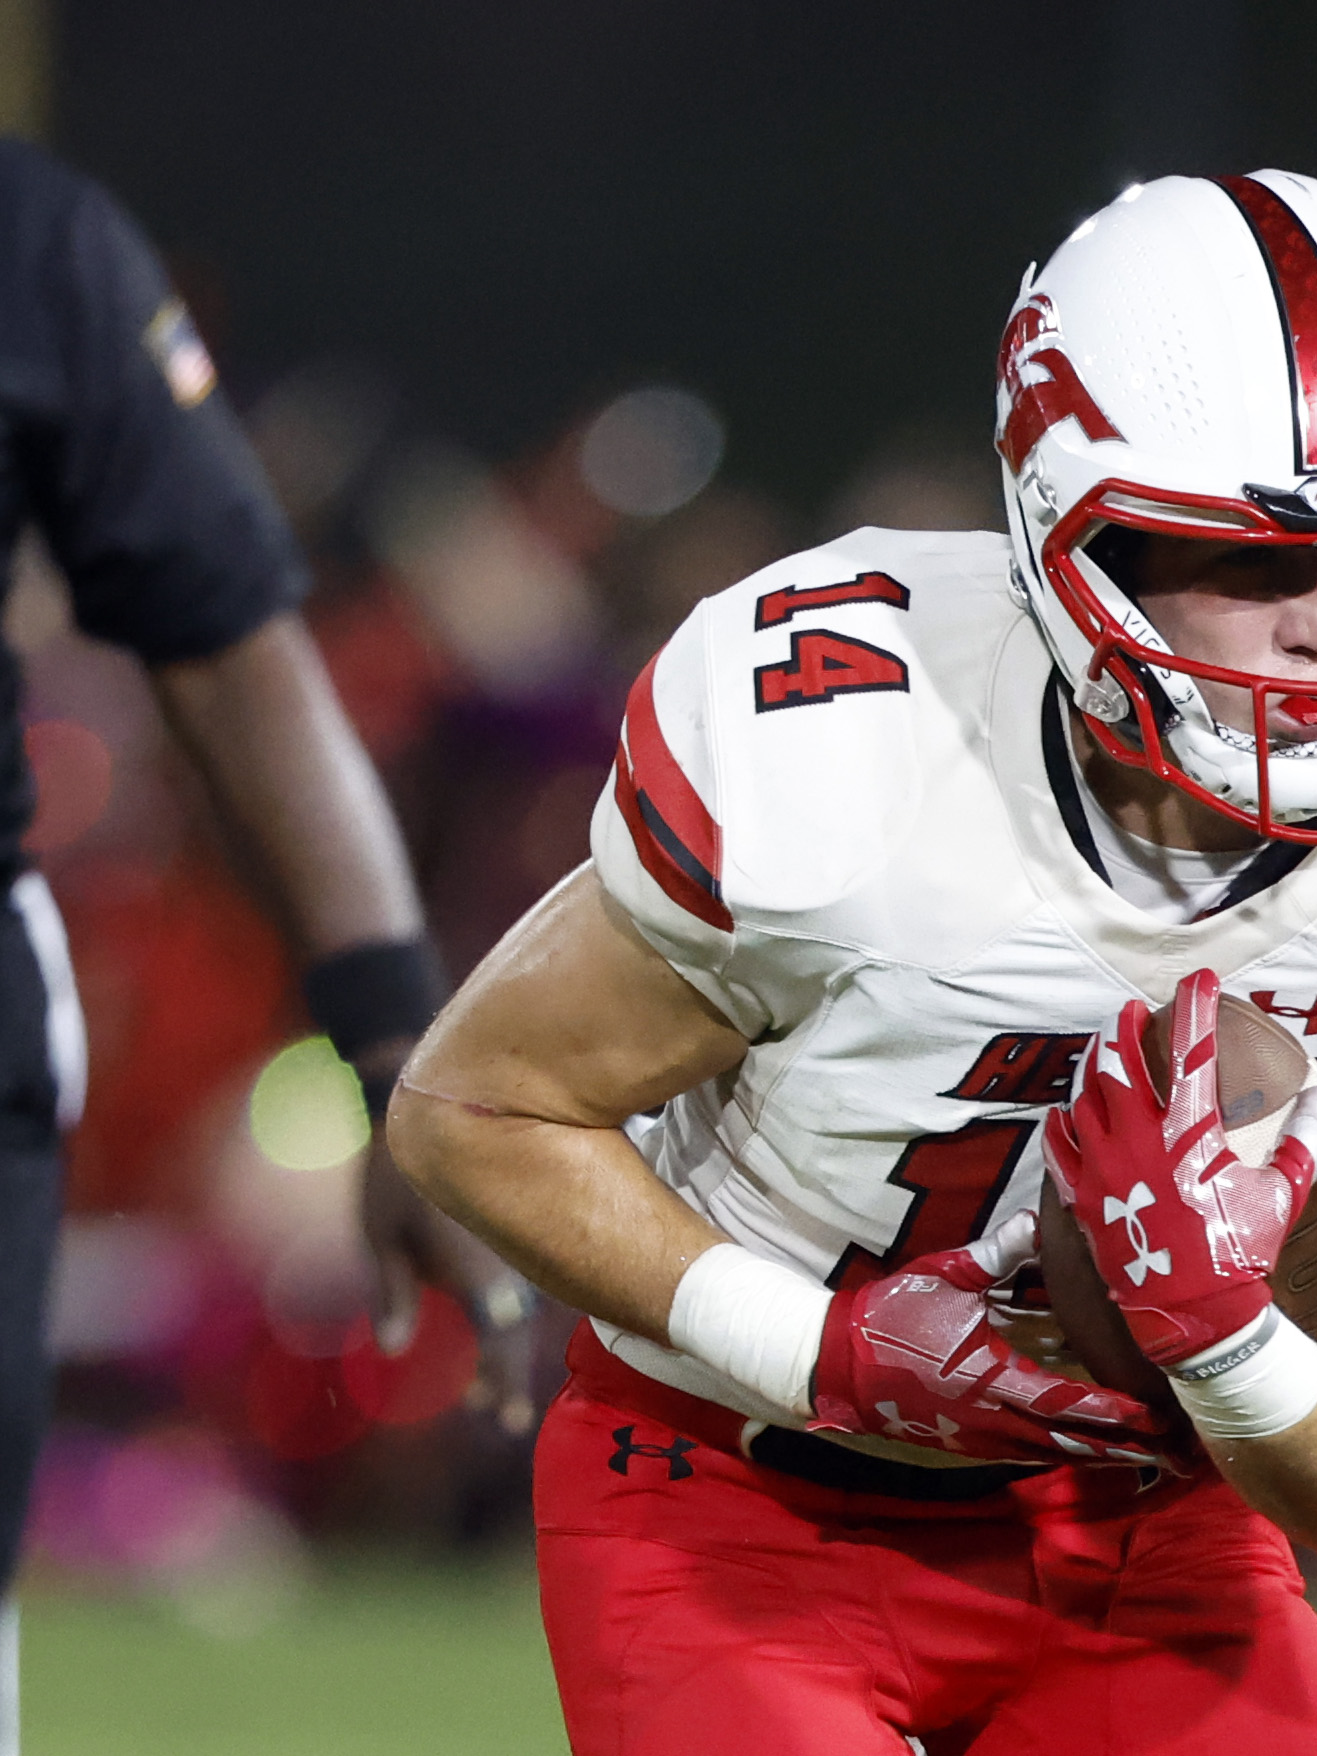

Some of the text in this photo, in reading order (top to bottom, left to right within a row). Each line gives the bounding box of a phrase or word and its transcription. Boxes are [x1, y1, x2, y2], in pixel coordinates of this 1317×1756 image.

[754, 571, 911, 714] 14
[824, 1117, 1051, 1312] 1
[1196, 1341, 1260, 1378] BIGGER
